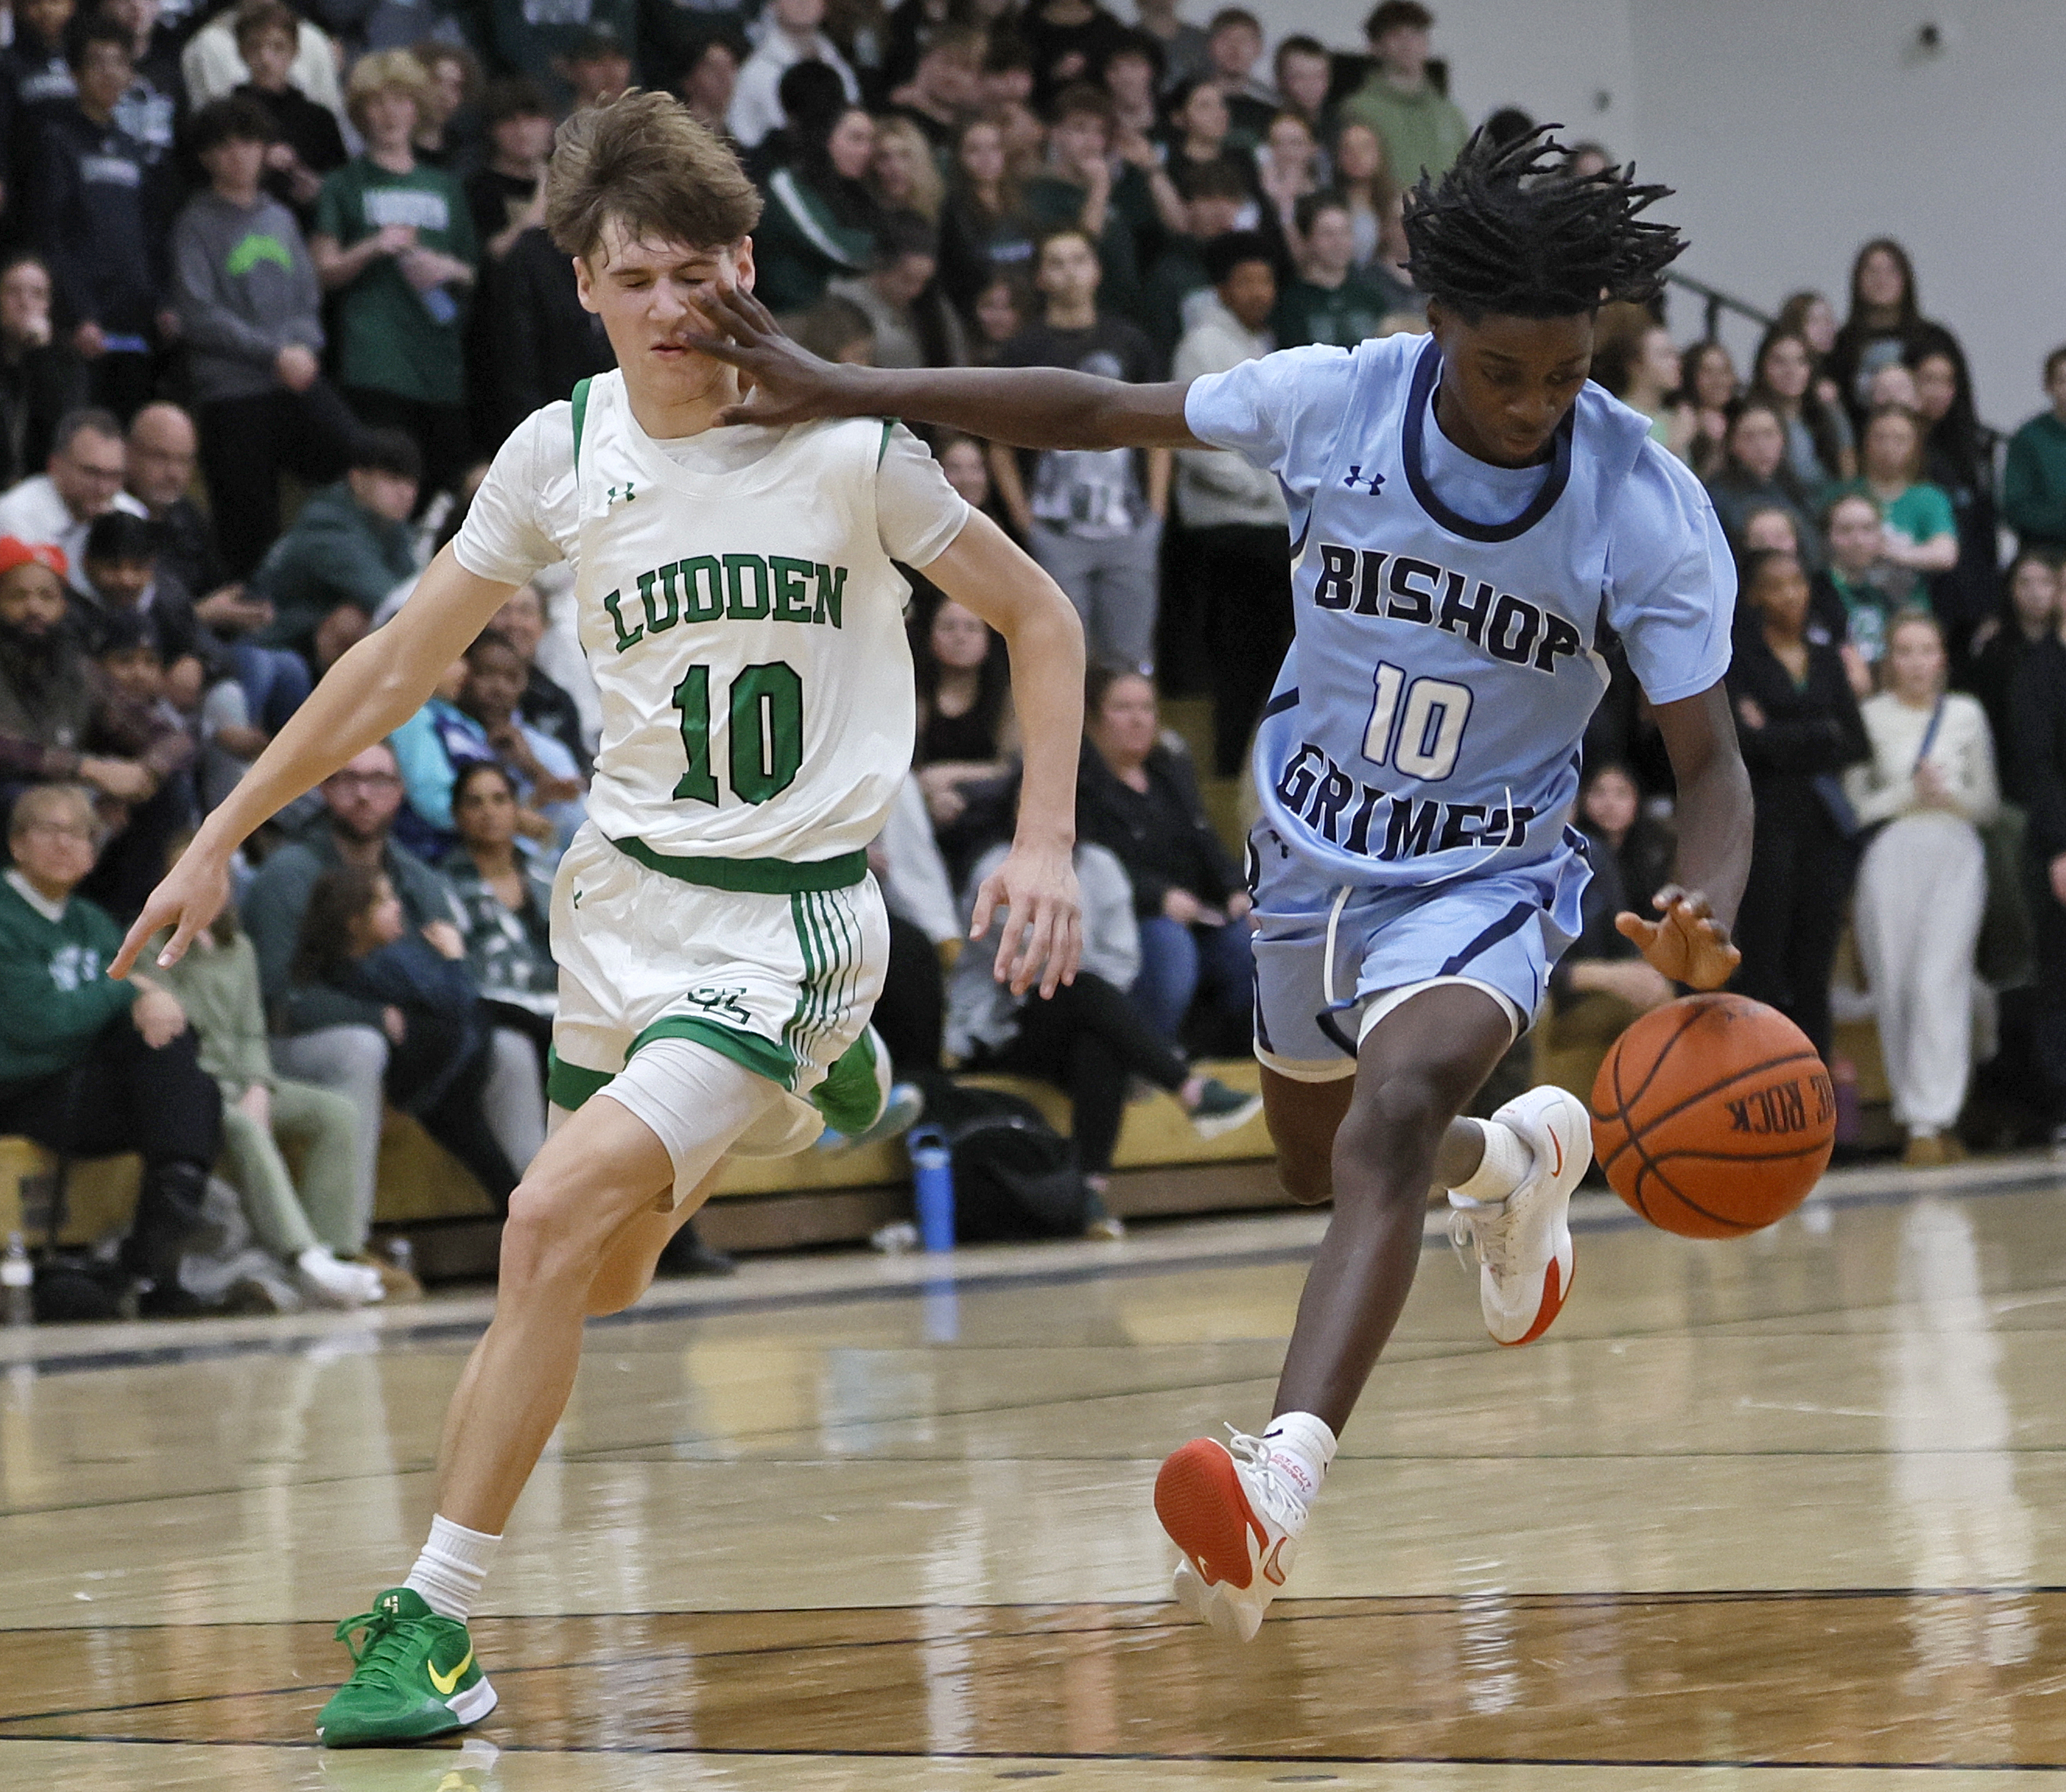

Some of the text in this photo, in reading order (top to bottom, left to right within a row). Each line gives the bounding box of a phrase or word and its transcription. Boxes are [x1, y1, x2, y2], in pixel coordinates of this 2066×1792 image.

[604, 554, 848, 654] LUDDEN
[1313, 542, 1582, 675] BISHOP
[672, 661, 803, 808] 10
[1361, 660, 1474, 782] 10
[1725, 1078, 1806, 1134] ROCK
